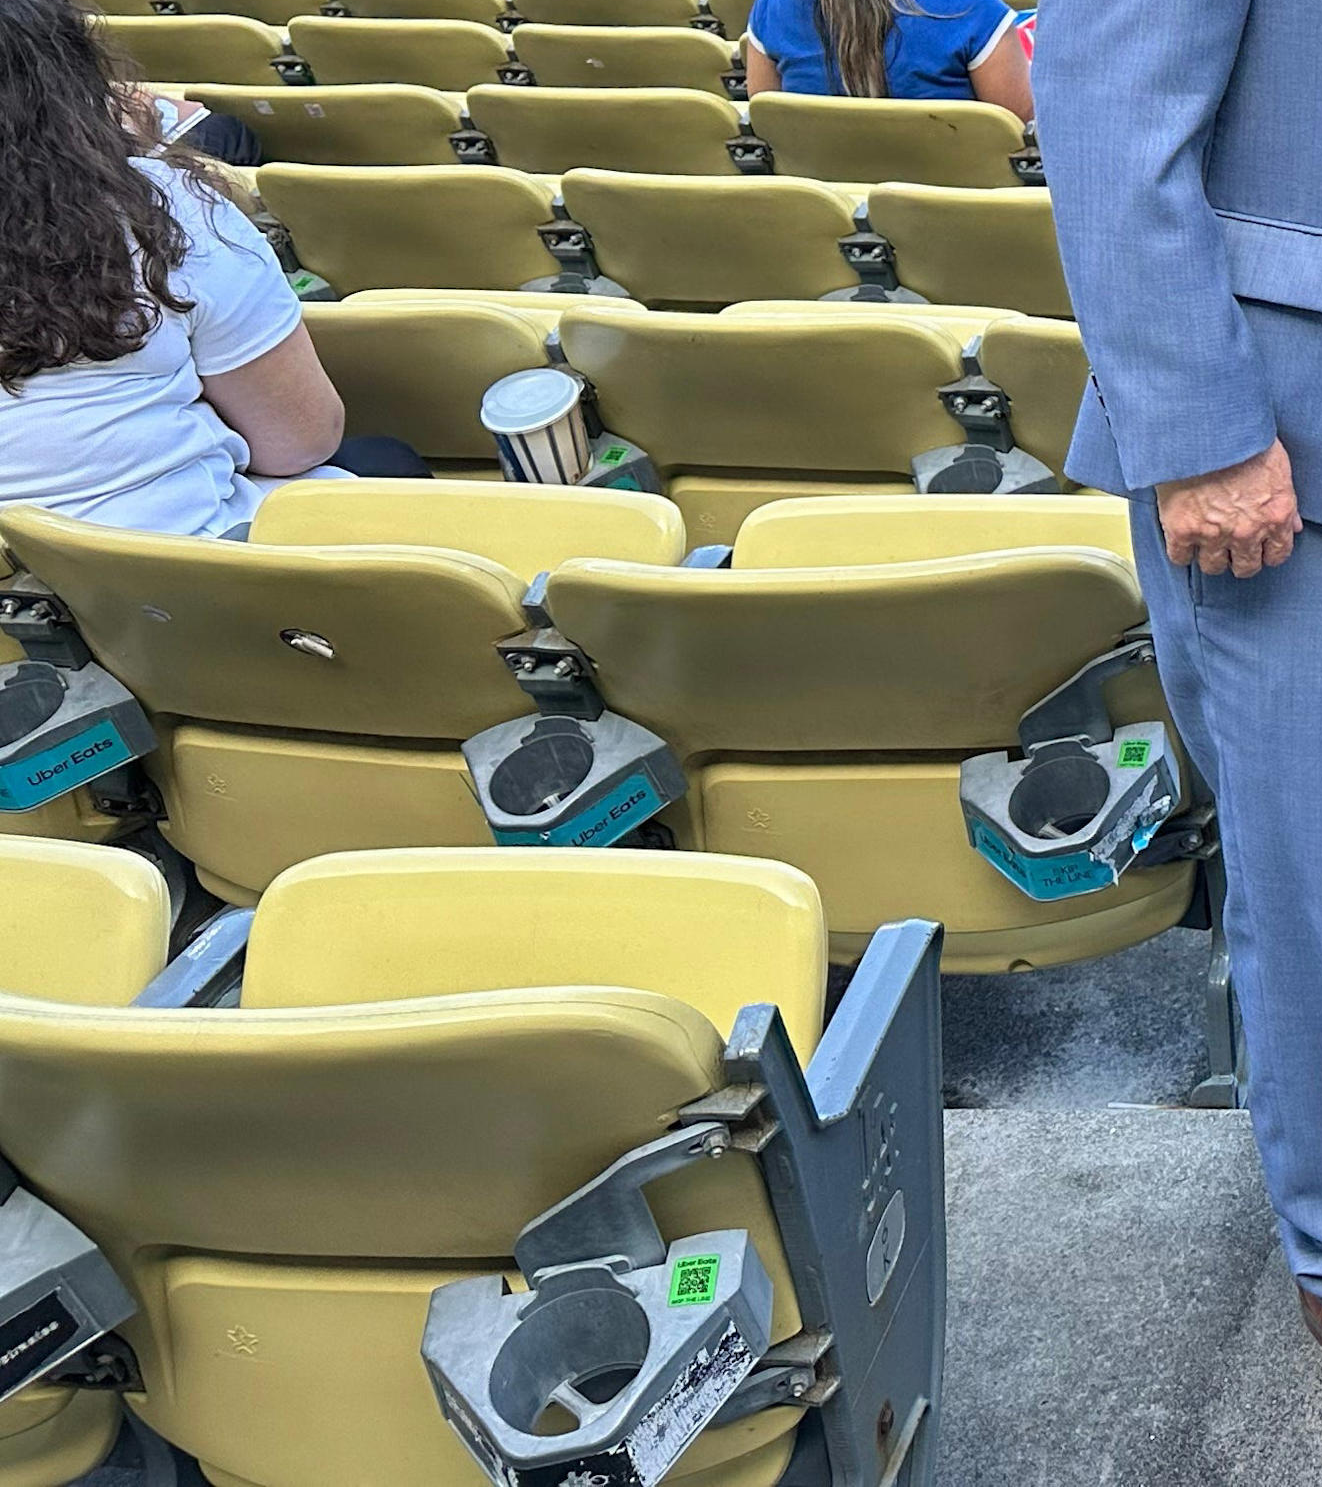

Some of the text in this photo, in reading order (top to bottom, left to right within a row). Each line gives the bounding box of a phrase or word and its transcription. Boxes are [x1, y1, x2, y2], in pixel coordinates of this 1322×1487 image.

[27, 738, 114, 787] Uber Eats
[571, 788, 647, 846] Uber Eats
